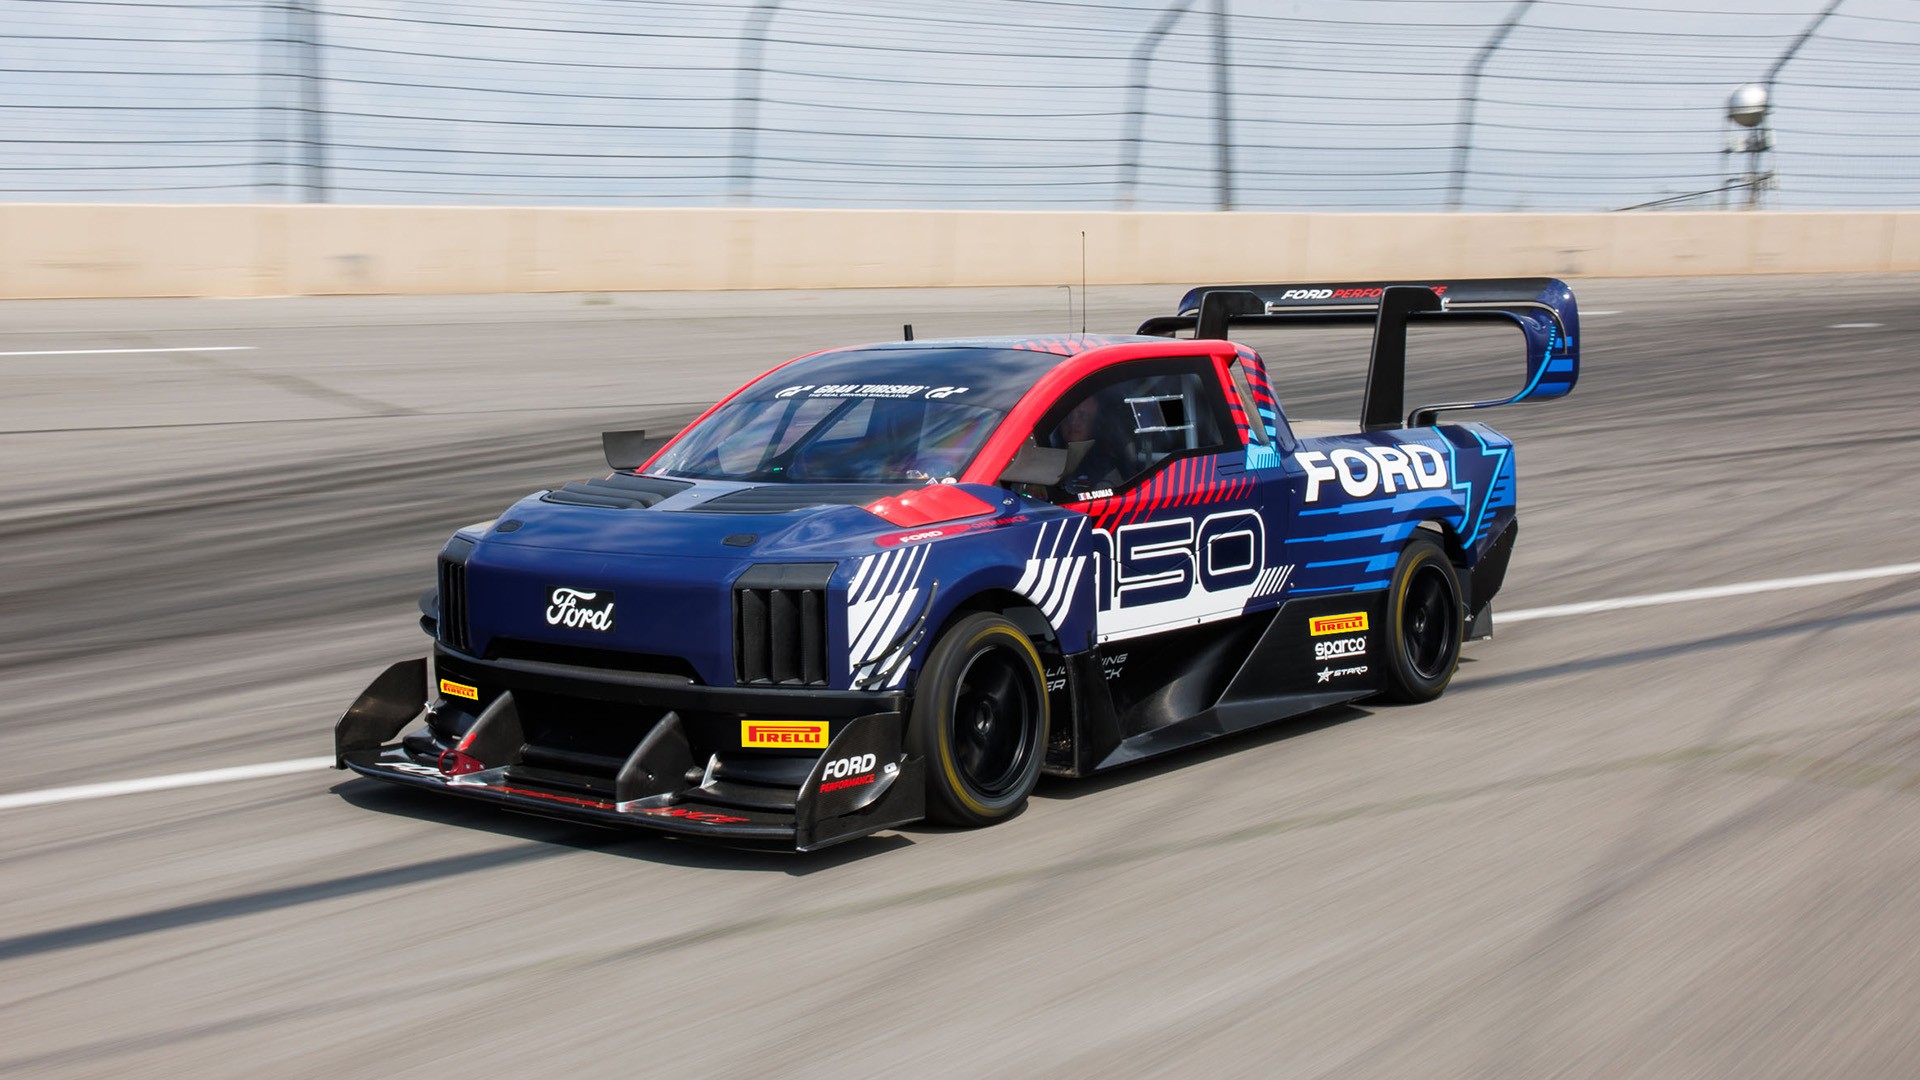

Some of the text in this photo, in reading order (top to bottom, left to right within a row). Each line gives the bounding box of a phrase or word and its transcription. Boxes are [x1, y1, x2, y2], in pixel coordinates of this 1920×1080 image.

[1281, 286, 1448, 300] FORD PERFOCE
[814, 385, 924, 394] GRAN TURISMO
[1294, 444, 1448, 502] FORD
[899, 530, 943, 543] FORD
[546, 587, 614, 631] Ford
[1314, 615, 1364, 633] PIRELLI
[1315, 636, 1366, 660] sparco
[1333, 665, 1369, 677] STARD
[443, 682, 475, 697] PIRELLI
[748, 725, 822, 743] PIRELLI
[821, 753, 877, 782] FORD
[819, 773, 876, 794] PERFORMANCE
